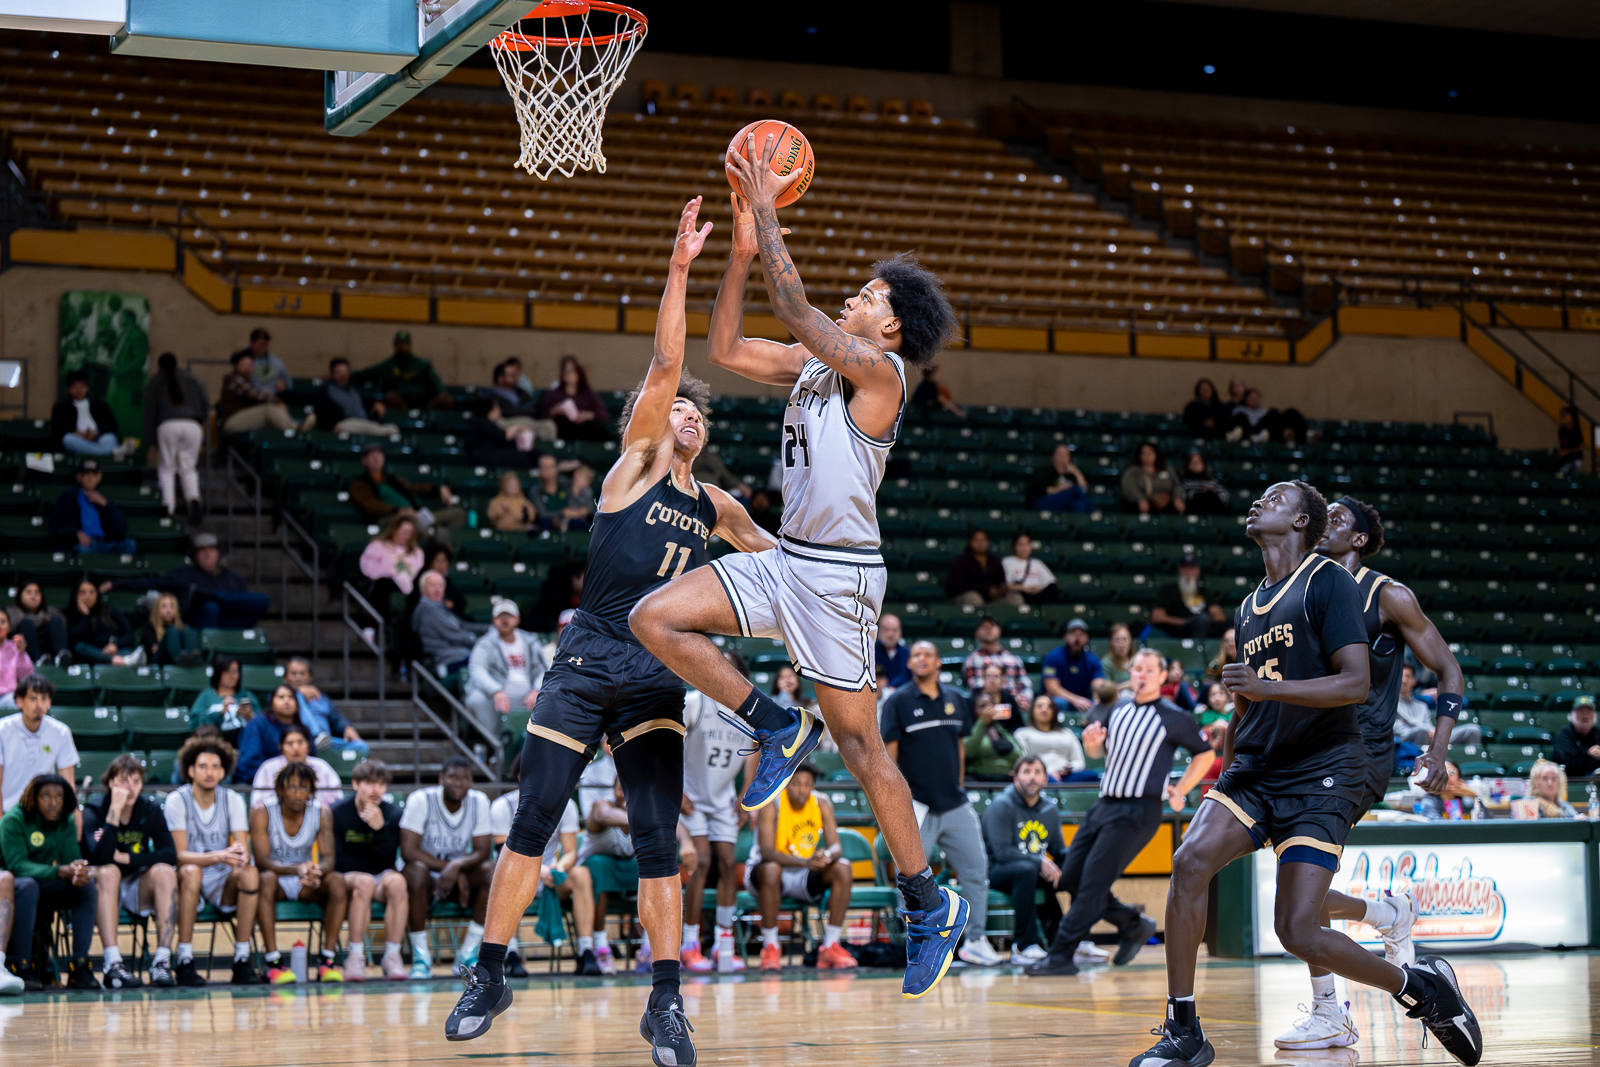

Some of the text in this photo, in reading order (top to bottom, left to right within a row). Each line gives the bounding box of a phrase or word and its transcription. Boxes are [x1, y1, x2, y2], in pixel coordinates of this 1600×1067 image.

[779, 135, 803, 177] ALDING
[784, 423, 810, 468] 24
[645, 501, 709, 546] COYOTE
[657, 541, 692, 580] 11
[1257, 657, 1283, 681] 5
[707, 747, 732, 768] 23
